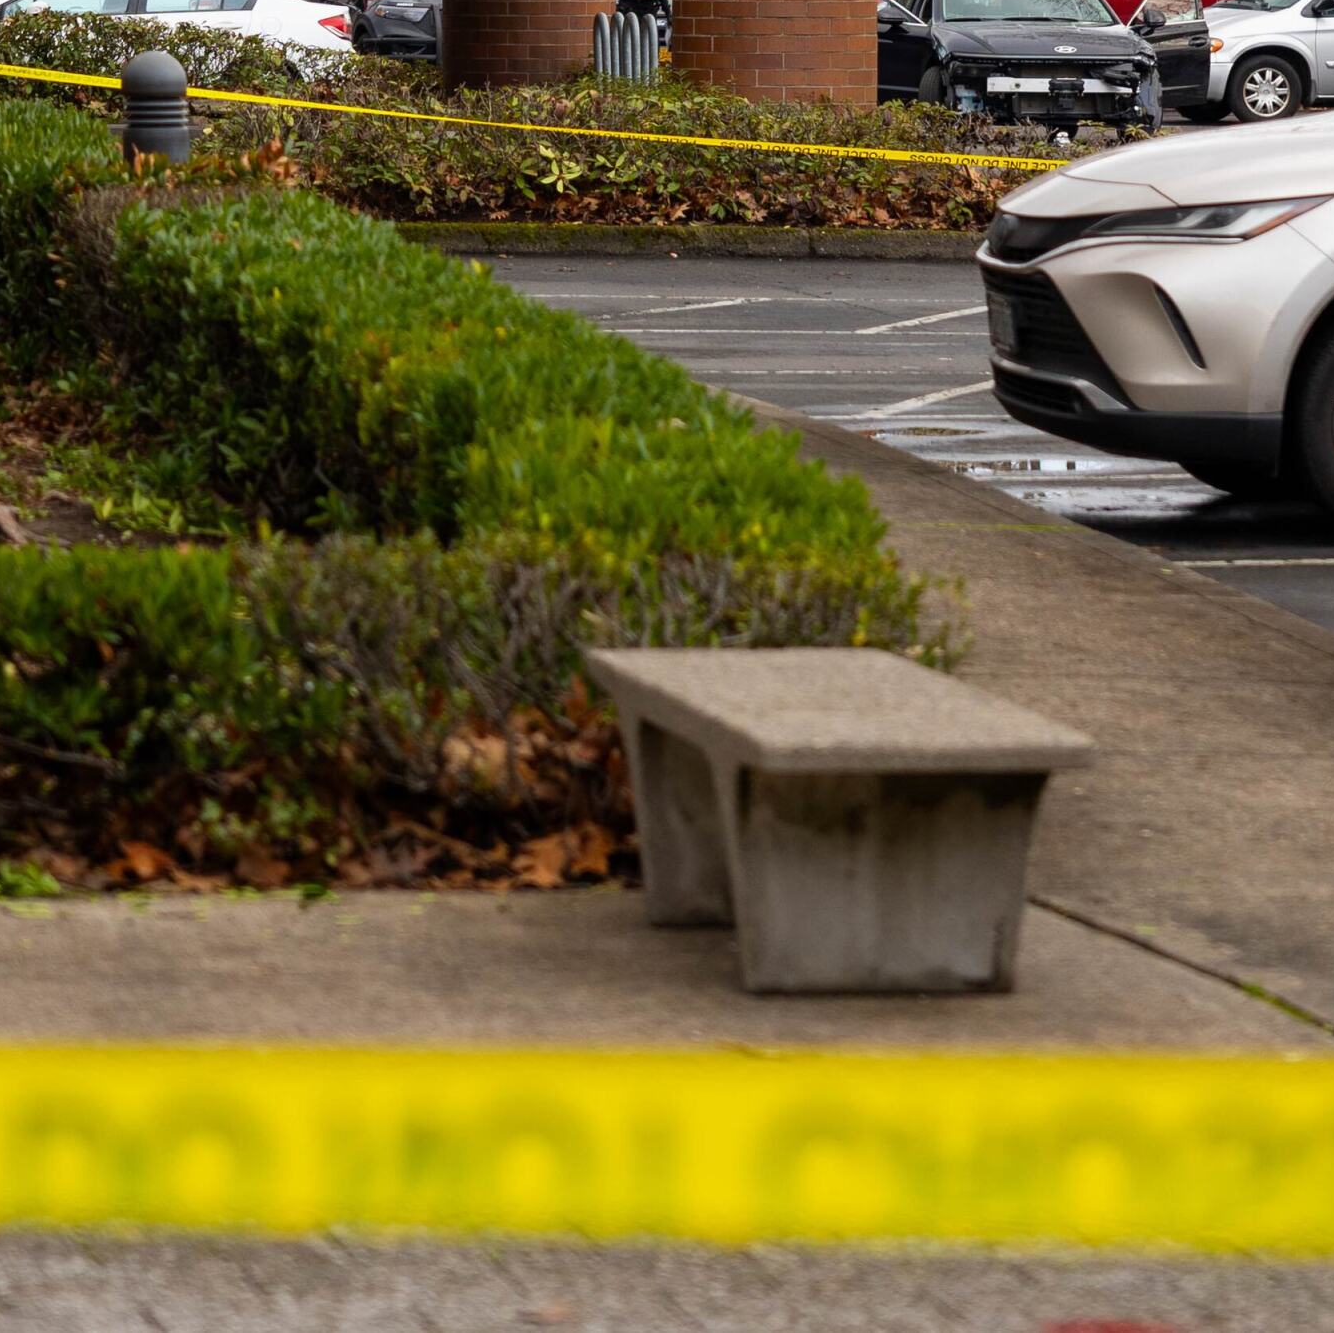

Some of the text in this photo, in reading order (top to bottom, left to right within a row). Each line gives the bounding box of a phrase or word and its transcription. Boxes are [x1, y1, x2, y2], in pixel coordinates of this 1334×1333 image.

[767, 145, 790, 153] NOT
[793, 146, 811, 155] DO
[814, 148, 840, 157] LINE
[843, 150, 886, 159] POLICE
[910, 154, 952, 165] CROSS
[956, 157, 980, 166] NOT
[982, 158, 1000, 167] DO
[1003, 160, 1029, 170] LINE
